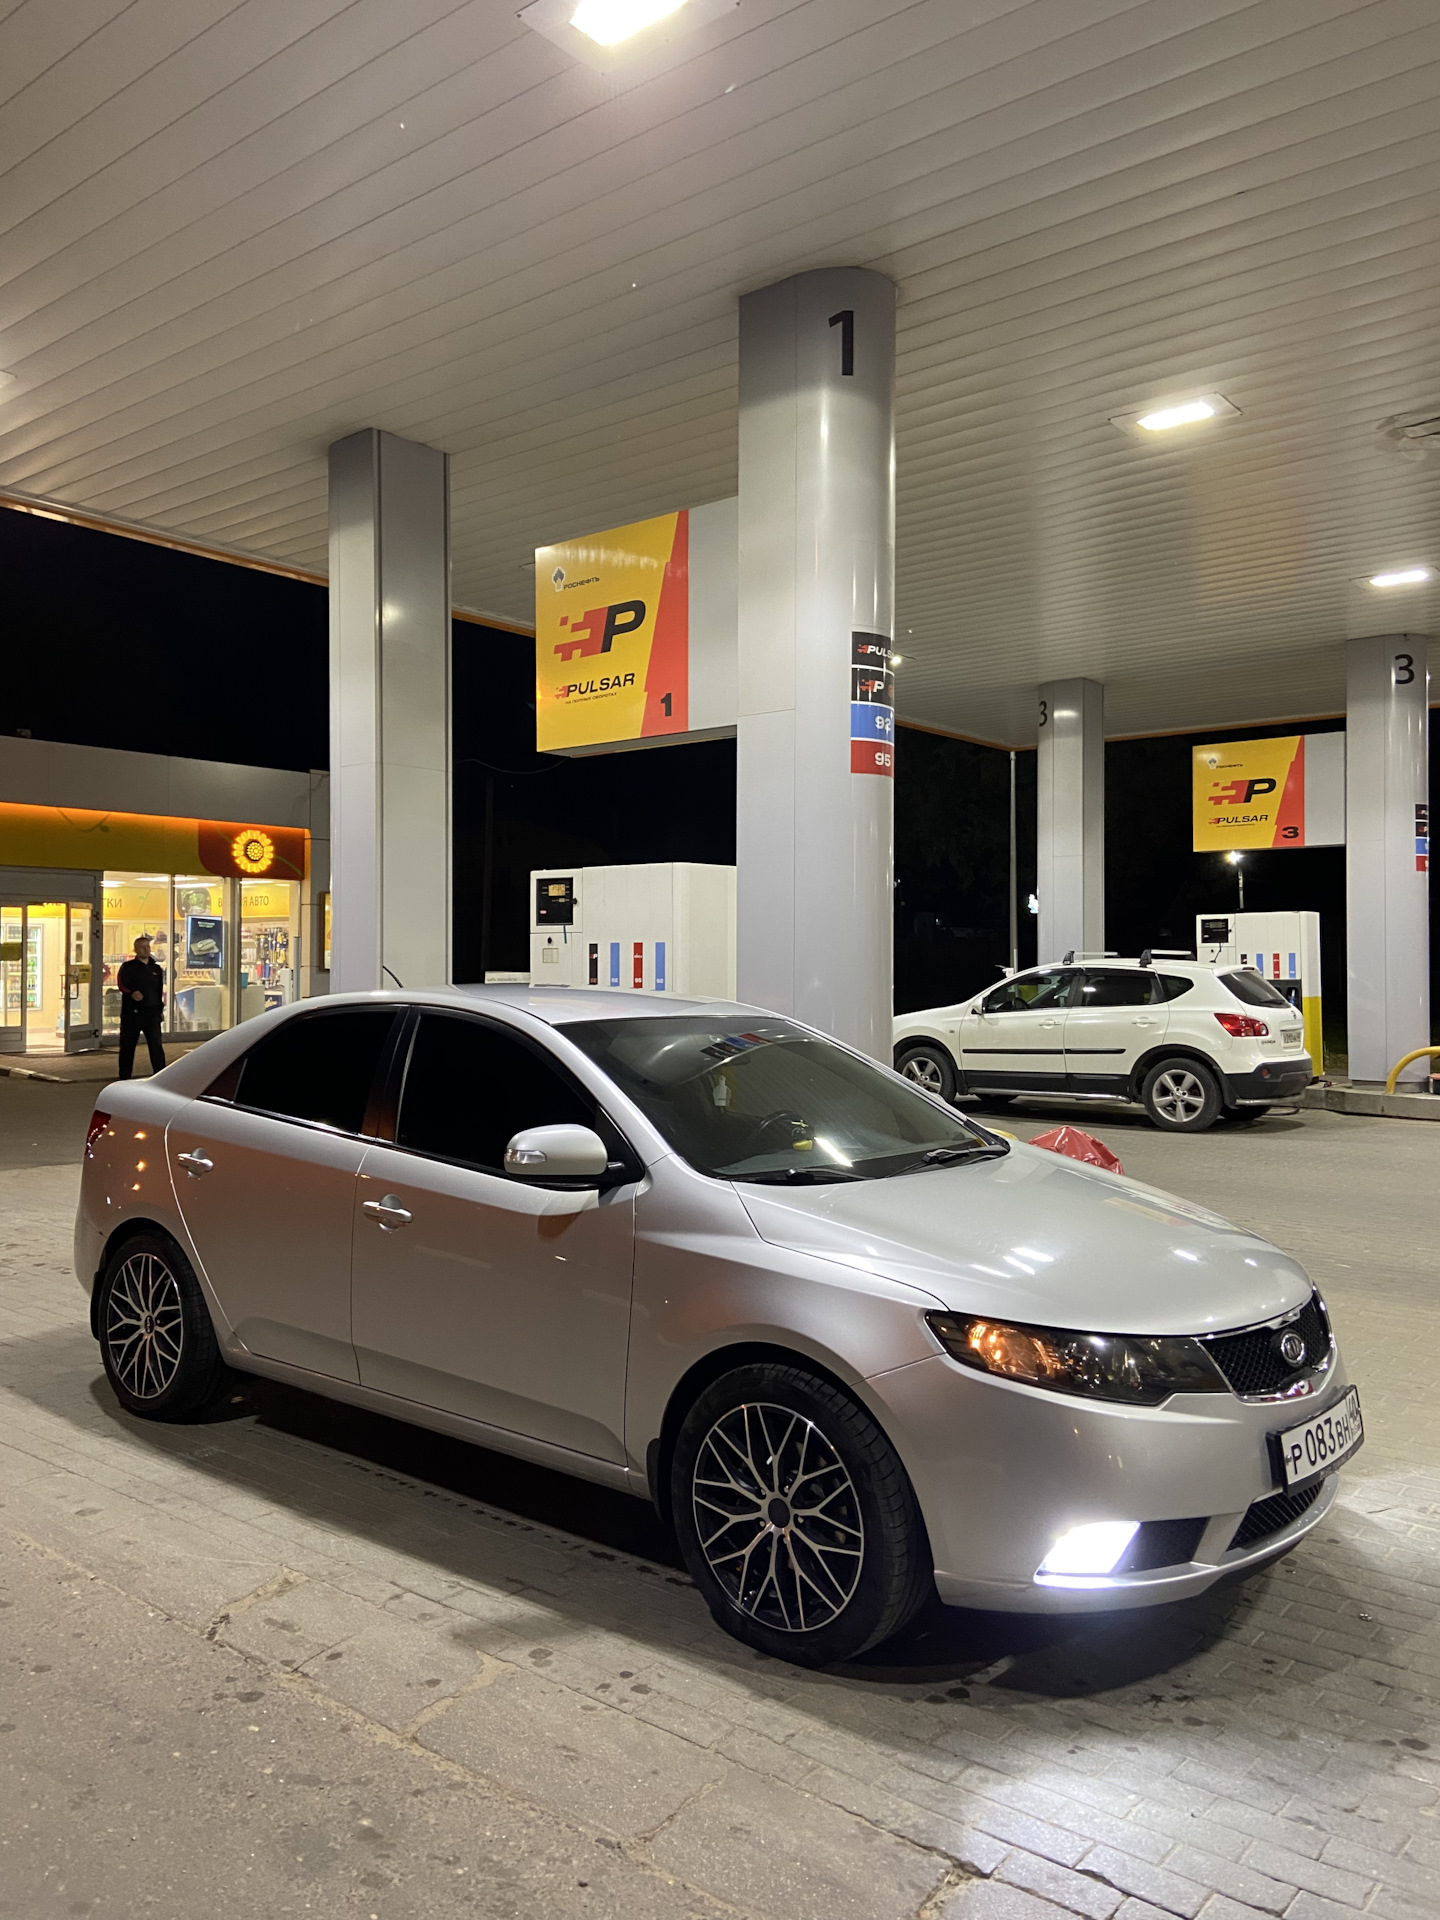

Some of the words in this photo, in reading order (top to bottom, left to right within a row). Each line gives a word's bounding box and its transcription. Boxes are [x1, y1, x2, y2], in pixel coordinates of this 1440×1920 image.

[828, 310, 854, 377] 1
[563, 576, 600, 590] РОСНЕФТЬ
[1394, 653, 1415, 685] 3
[566, 672, 635, 698] PULSAR
[660, 692, 672, 717] 1
[1039, 700, 1048, 727] 3
[875, 715, 892, 732] 92
[874, 752, 891, 767] 95
[1217, 814, 1269, 825] PULSAR
[1282, 826, 1299, 839] 3
[249, 895, 269, 907] АВТО
